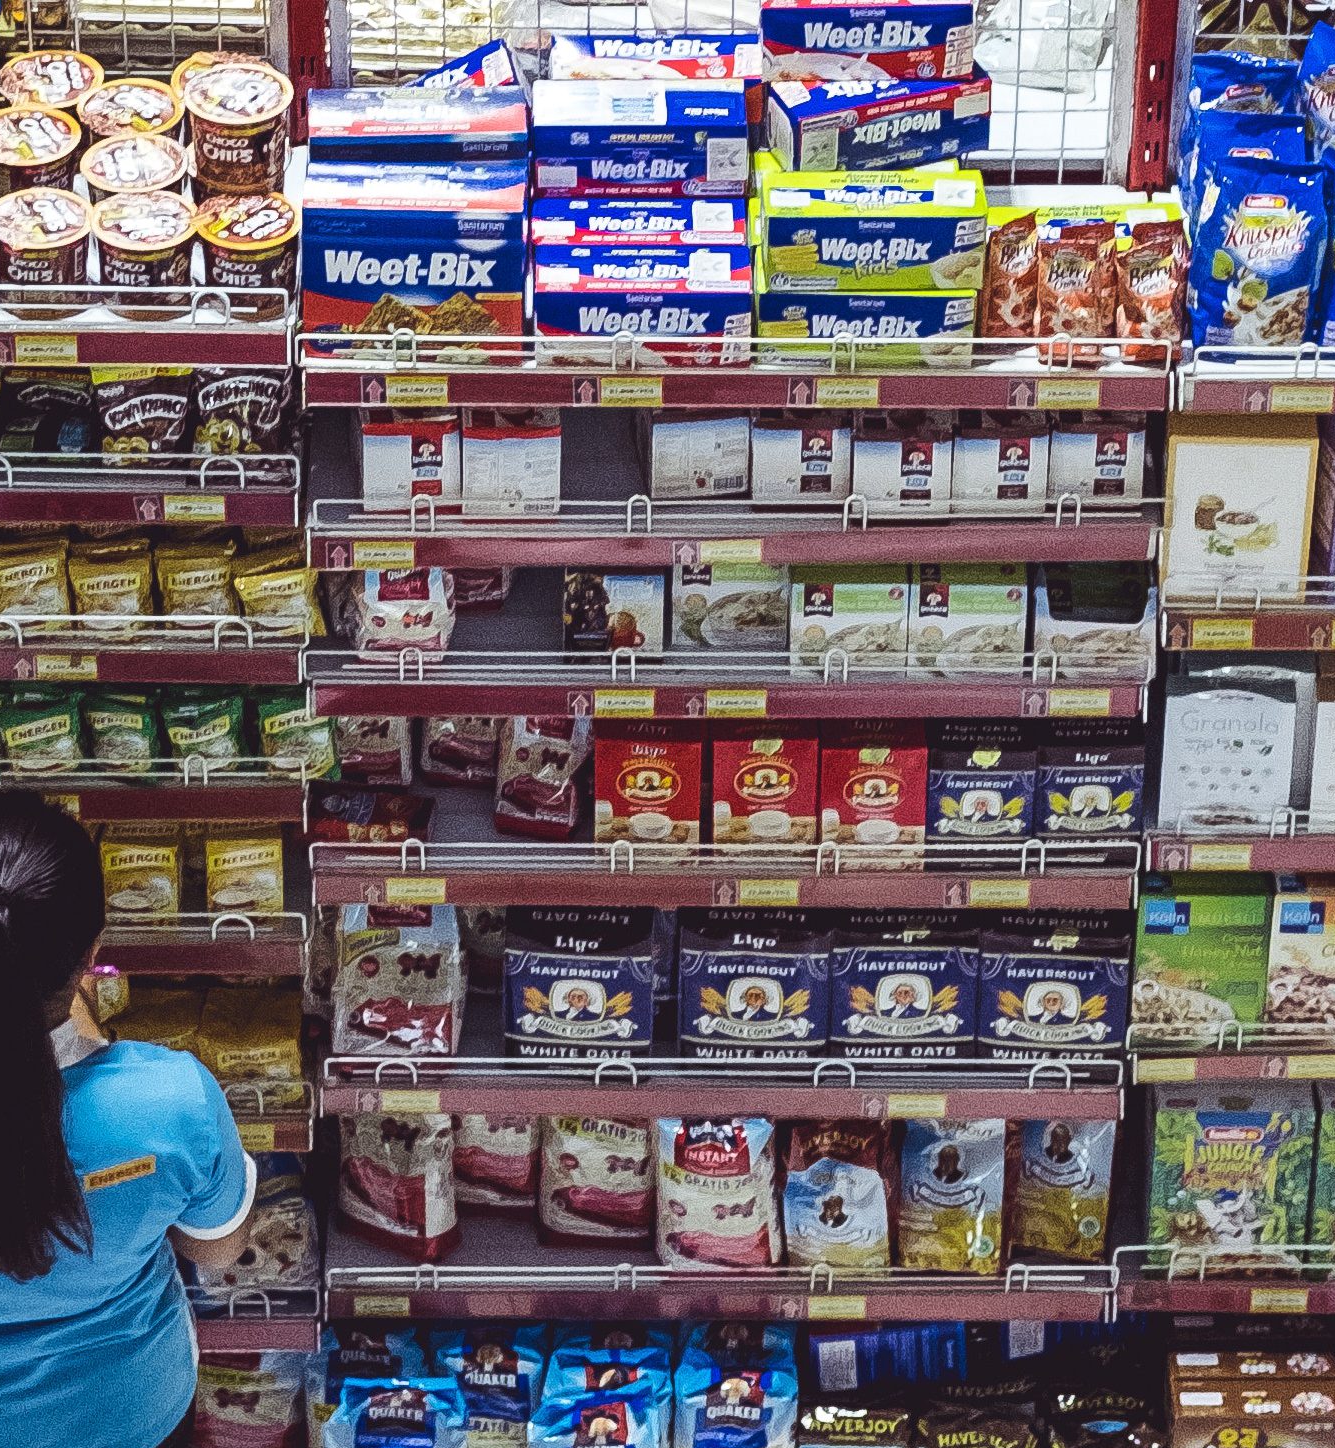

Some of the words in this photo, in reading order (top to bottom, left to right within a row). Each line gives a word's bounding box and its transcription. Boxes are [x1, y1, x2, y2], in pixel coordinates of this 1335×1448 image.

[804, 21, 931, 50] Weet-Bix
[594, 38, 721, 60] Weet-Bix
[206, 134, 248, 147] CHOCO
[203, 146, 253, 163] CHIPS
[592, 159, 688, 181] Weet-Bix
[824, 188, 923, 204] Weet-Bix
[588, 215, 688, 233] Weet-Bix
[1222, 222, 1308, 249] Knusper
[822, 238, 933, 263] Weet-Bix
[325, 250, 496, 286] Weet-Bix
[579, 307, 710, 334] Weet-Bix
[811, 315, 922, 339] Weet-Bix
[78, 576, 138, 591] ENERGEN
[9, 719, 70, 742] ENERGEN
[1074, 752, 1110, 765] Ligo
[109, 851, 173, 866] ENERGEN
[556, 936, 598, 952] Ligo
[733, 934, 776, 949] Ligo
[531, 966, 618, 978] HAVERMOUT
[708, 965, 796, 980] HAVERMOUT
[858, 961, 946, 971] HAVERMOUT
[1007, 966, 1095, 980] HAVERMOUT
[519, 1045, 577, 1059] WHITE
[696, 1046, 755, 1060] WHITE
[844, 1045, 898, 1058] WHITE
[905, 1045, 957, 1058] OATS
[992, 1047, 1051, 1060] WHITE
[1197, 1144, 1265, 1164] JUNGLE
[707, 1404, 760, 1420] QUAKER
